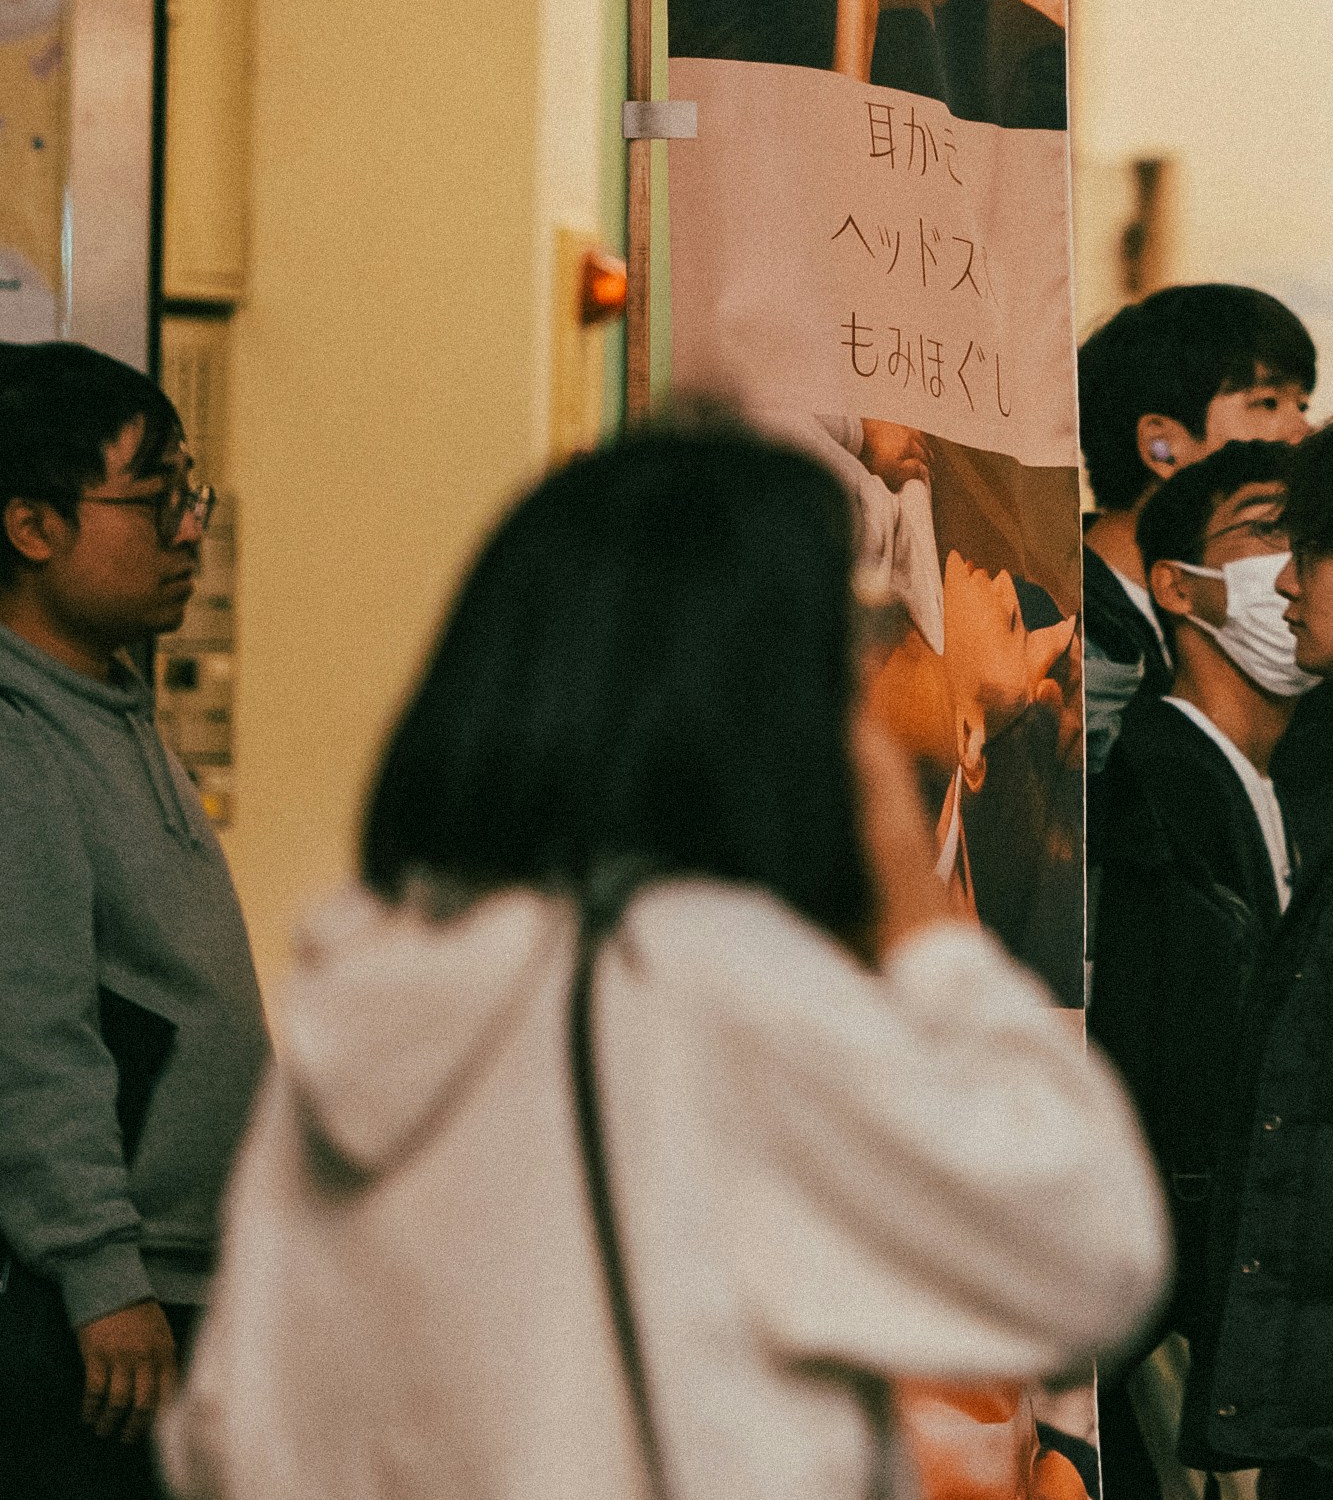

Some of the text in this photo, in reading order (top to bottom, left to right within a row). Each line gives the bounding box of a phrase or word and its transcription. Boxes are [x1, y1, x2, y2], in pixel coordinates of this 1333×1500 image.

[840, 311, 1013, 418] もみほぐし
